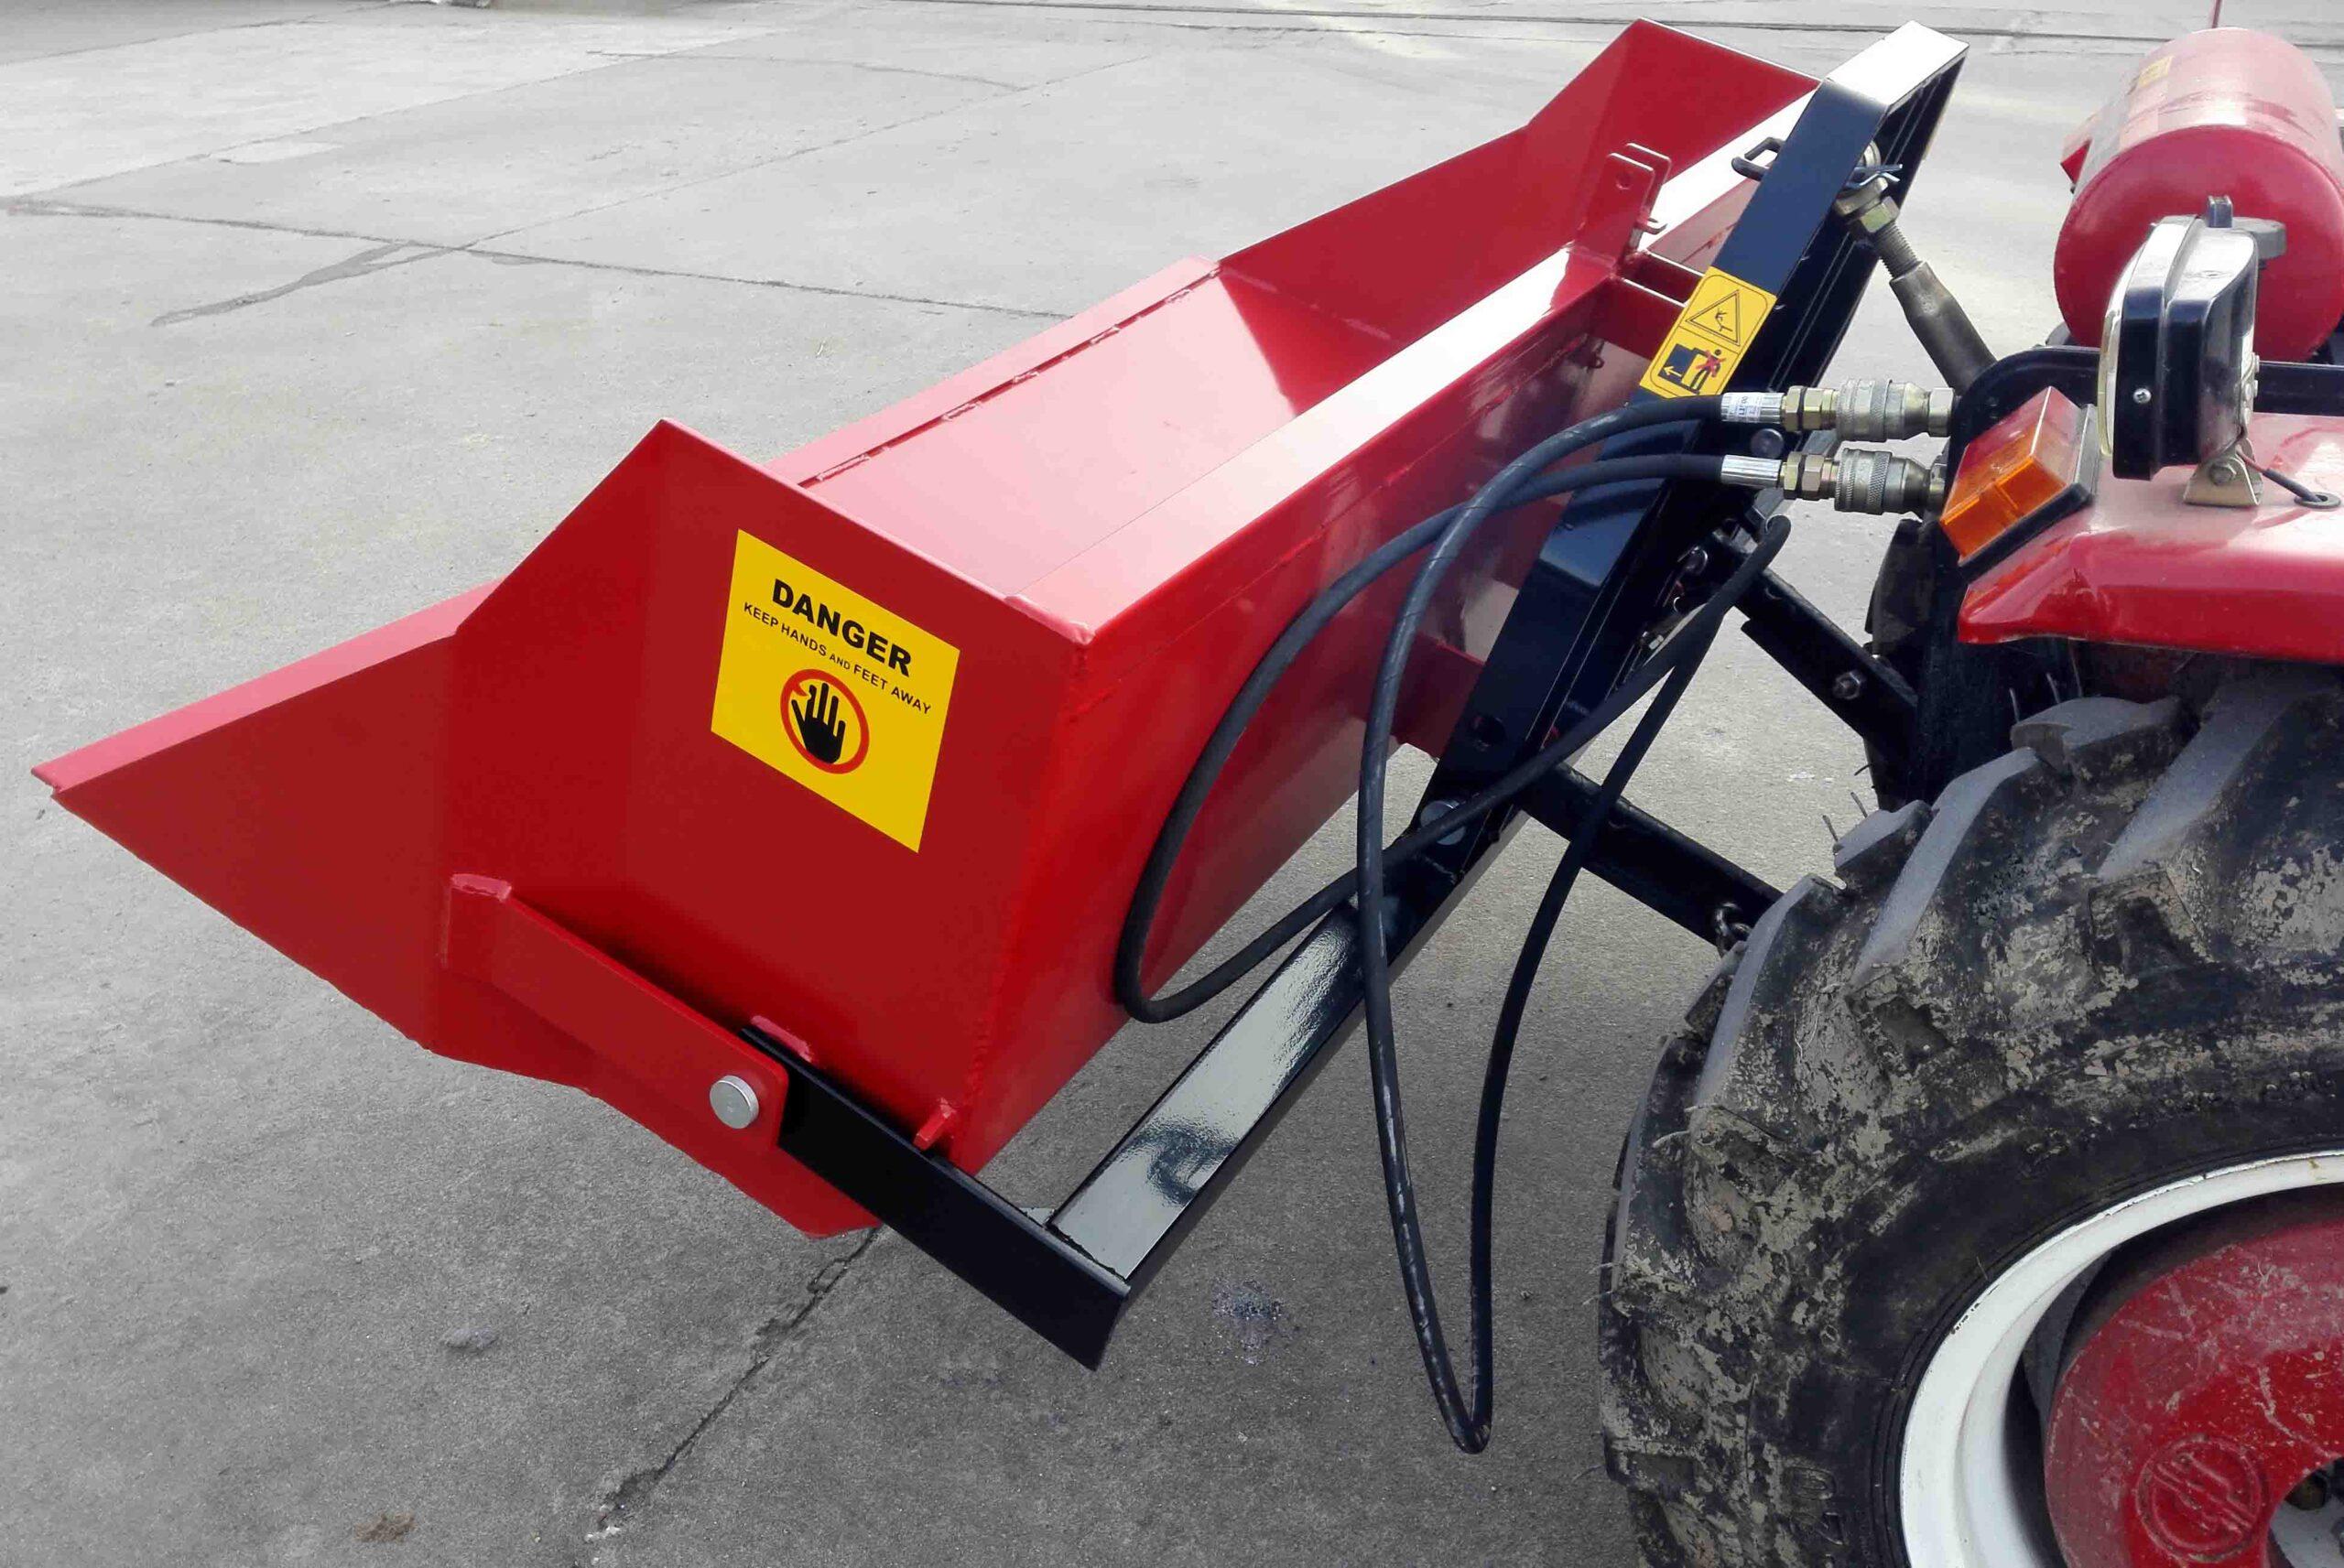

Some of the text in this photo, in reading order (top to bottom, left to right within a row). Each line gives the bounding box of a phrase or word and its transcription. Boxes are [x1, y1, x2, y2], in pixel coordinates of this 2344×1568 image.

[743, 601, 931, 715] KEEP HANDS AND FEET AWAY
[772, 578, 912, 677] DANGER
